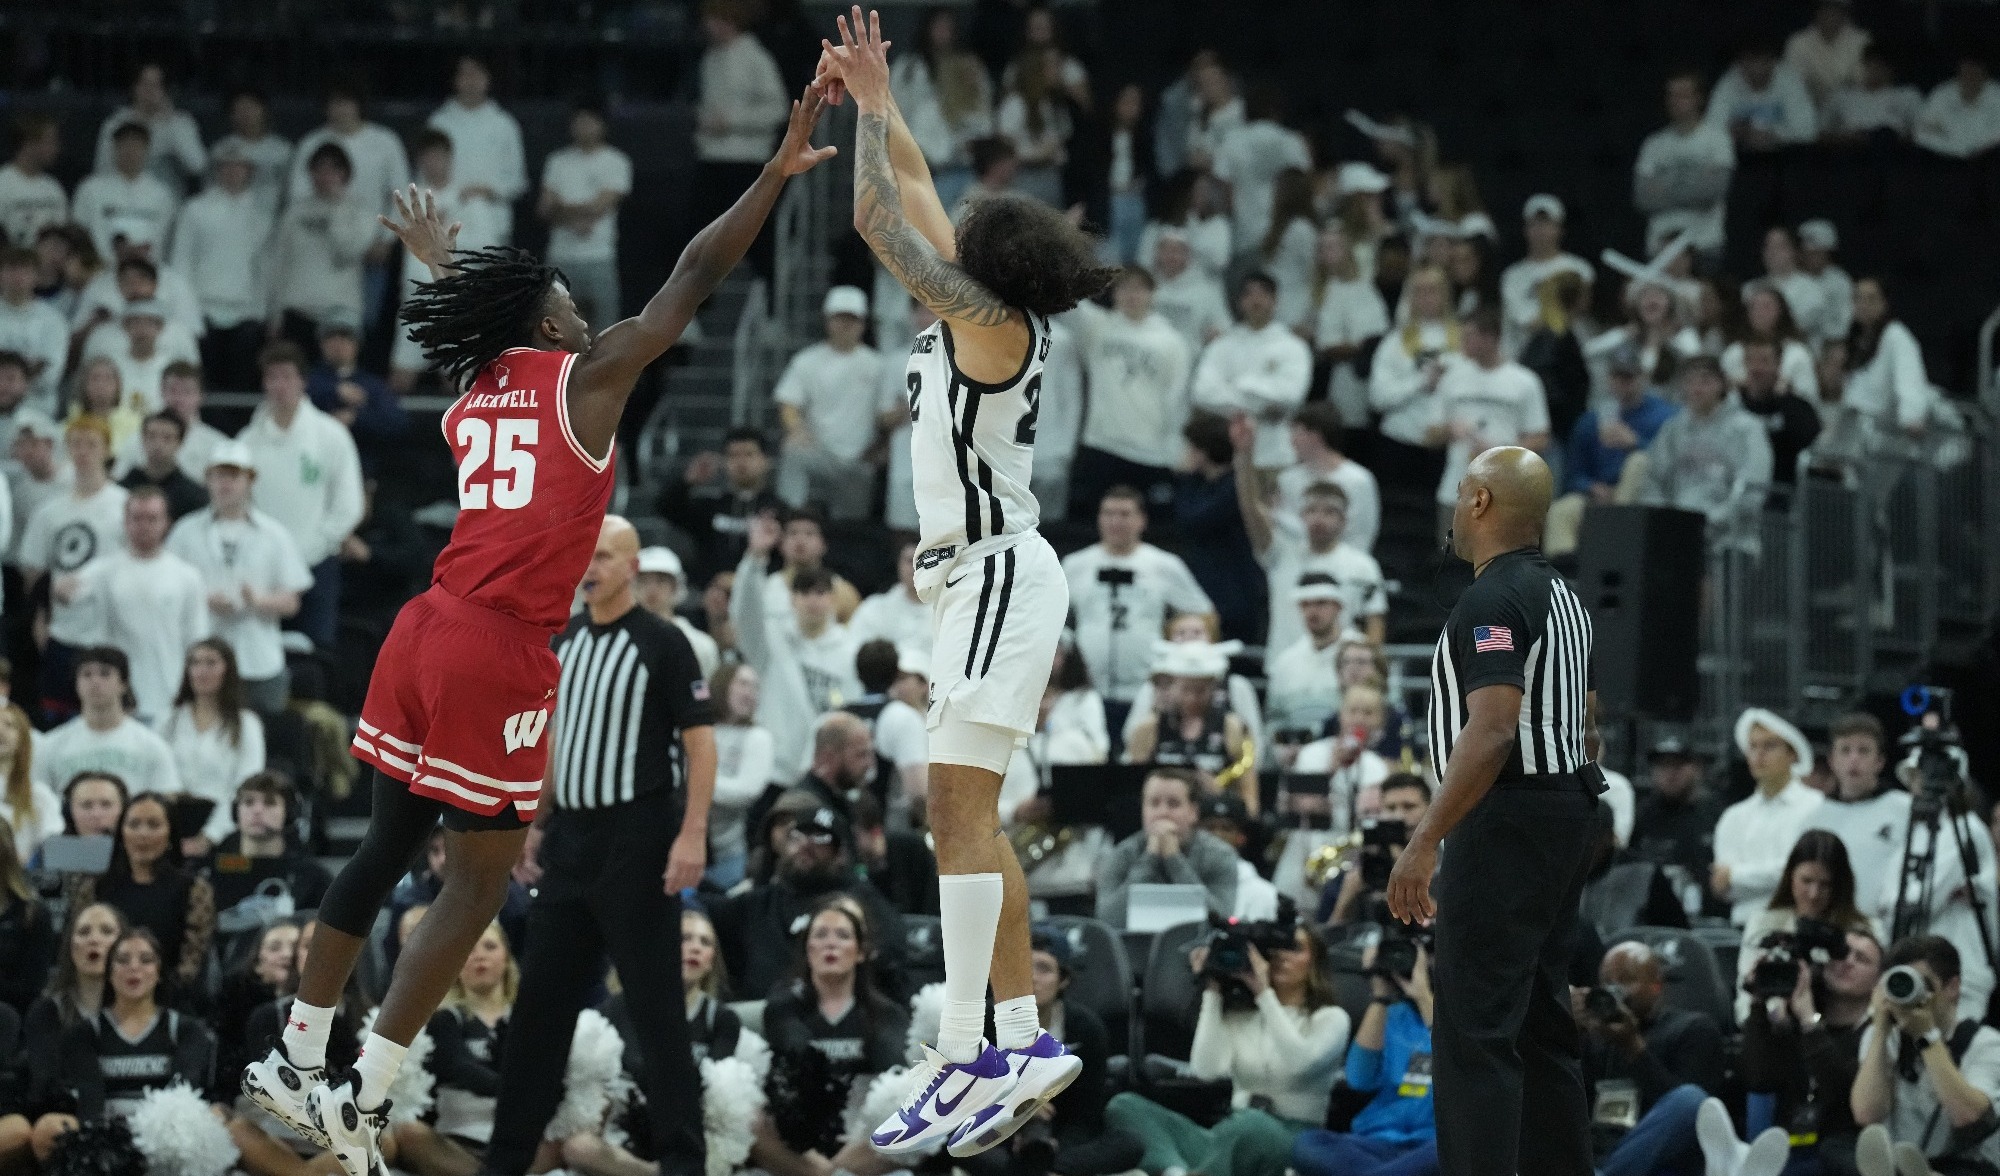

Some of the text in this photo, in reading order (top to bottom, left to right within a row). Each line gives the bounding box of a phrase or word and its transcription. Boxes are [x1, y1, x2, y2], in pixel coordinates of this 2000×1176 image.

[463, 390, 539, 412] LACKWELL
[456, 418, 539, 510] 25
[502, 707, 548, 756] W
